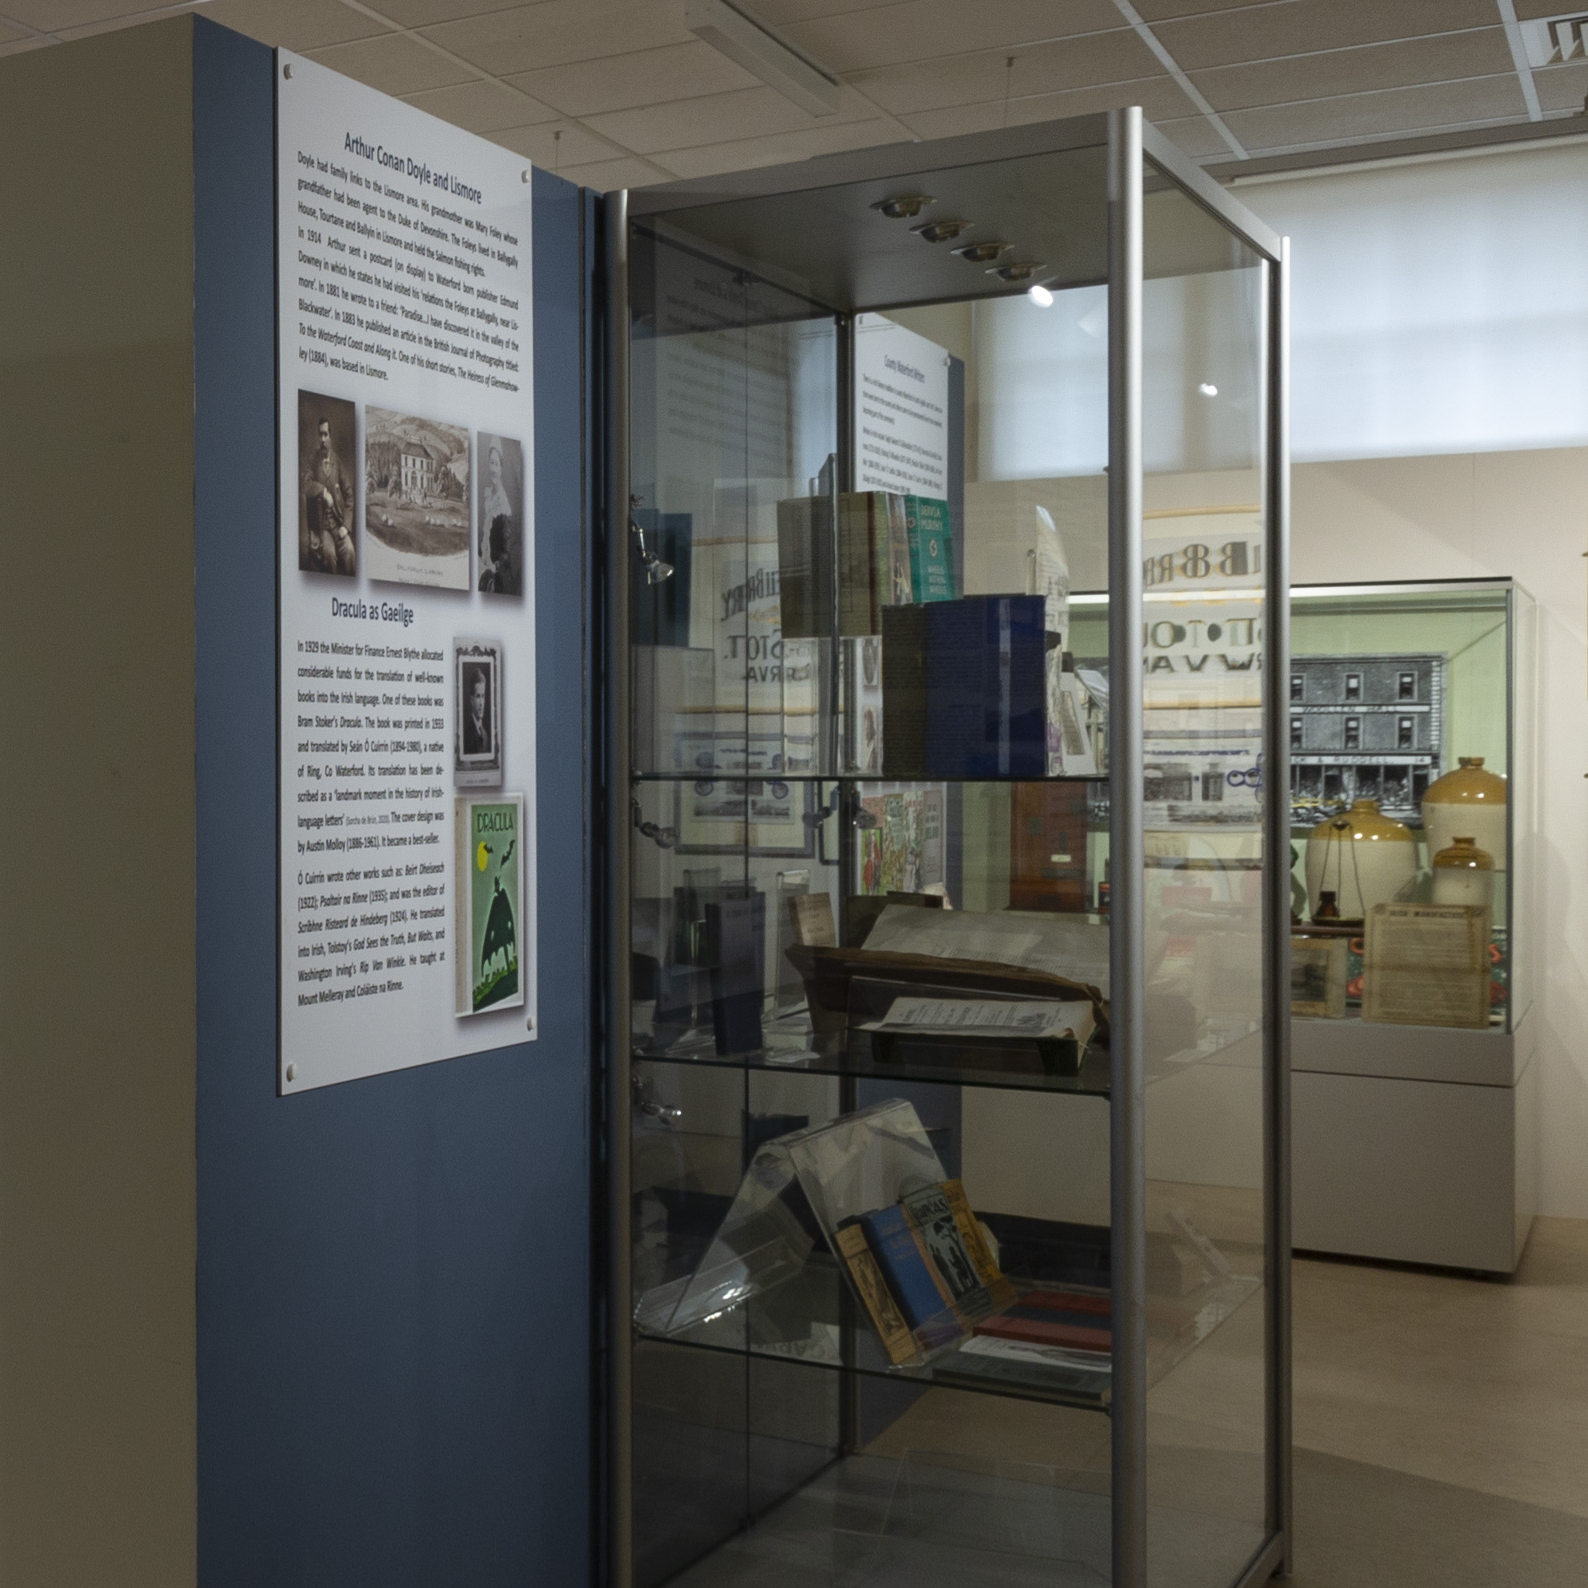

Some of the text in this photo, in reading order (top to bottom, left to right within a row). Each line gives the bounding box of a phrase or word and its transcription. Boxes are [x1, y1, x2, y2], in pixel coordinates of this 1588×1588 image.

[344, 131, 481, 205] Arthur Conan Doyle and Lismore
[297, 150, 518, 246] Doyle had family links to the Lismore area. His grandmother was Mary Foley whose
[331, 597, 414, 628] Dracula as Gaeilge
[297, 640, 443, 661] In 1929 the Minister for Finance Ernest Blythe allocated
[477, 812, 514, 833] DRACULA
